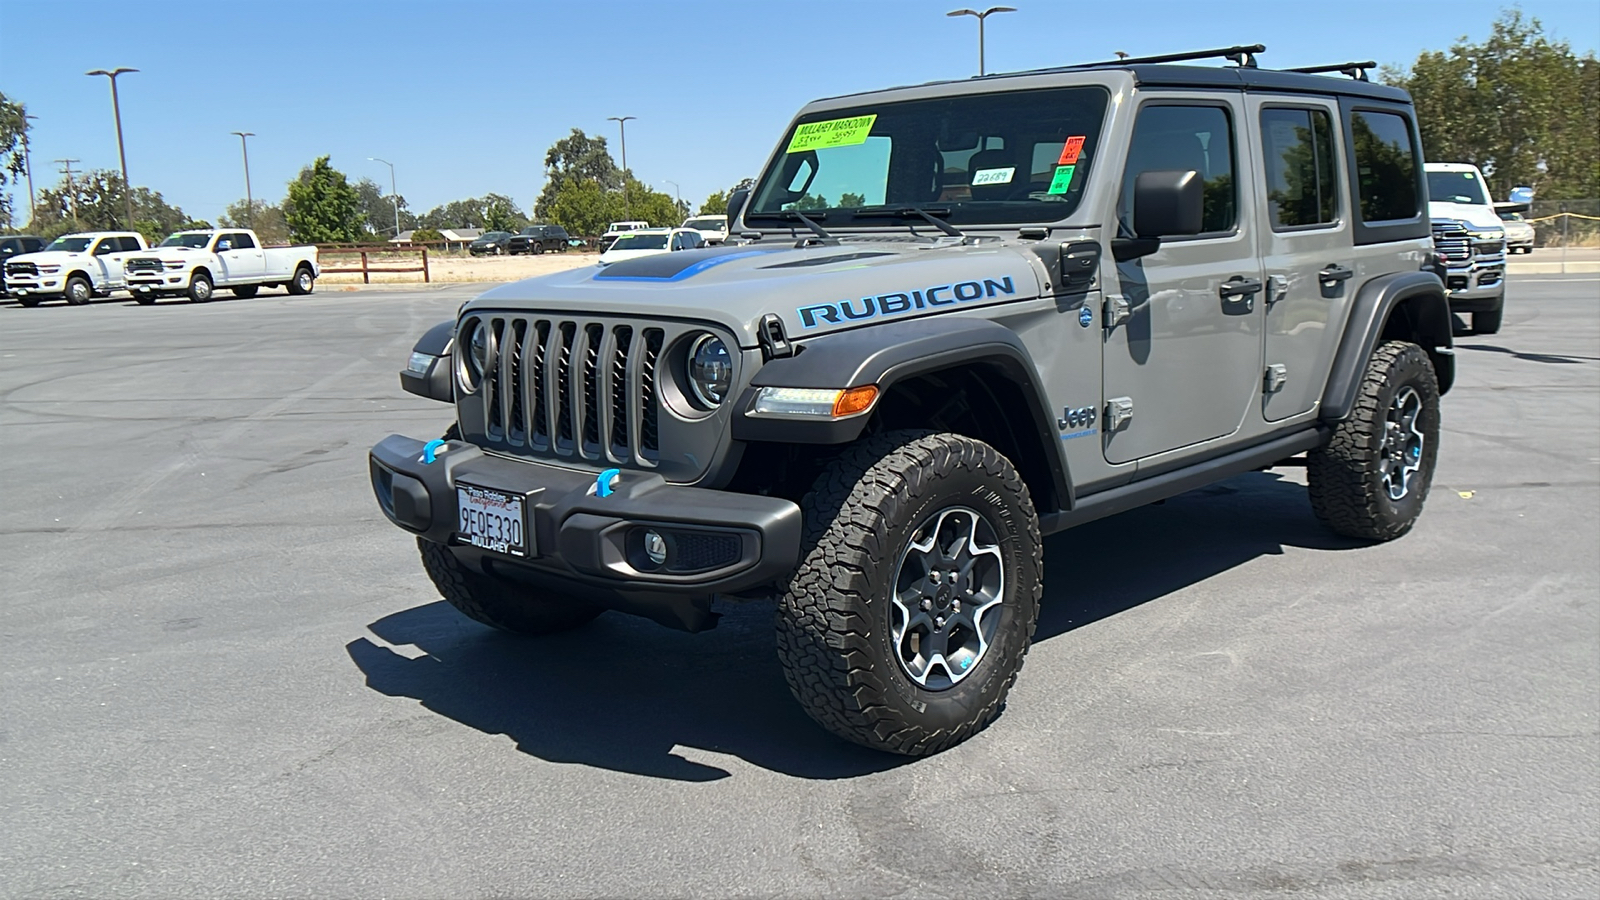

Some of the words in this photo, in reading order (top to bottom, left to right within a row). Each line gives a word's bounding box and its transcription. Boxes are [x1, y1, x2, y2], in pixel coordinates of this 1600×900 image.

[800, 122, 834, 134] MULLAHEY
[832, 117, 873, 131] MARKDOWN
[977, 171, 1007, 183] 22689
[796, 275, 1016, 329] RUBICON
[1057, 405, 1097, 431] Jeep
[468, 487, 483, 498] Paso
[471, 535, 509, 553] MULLAHEY
